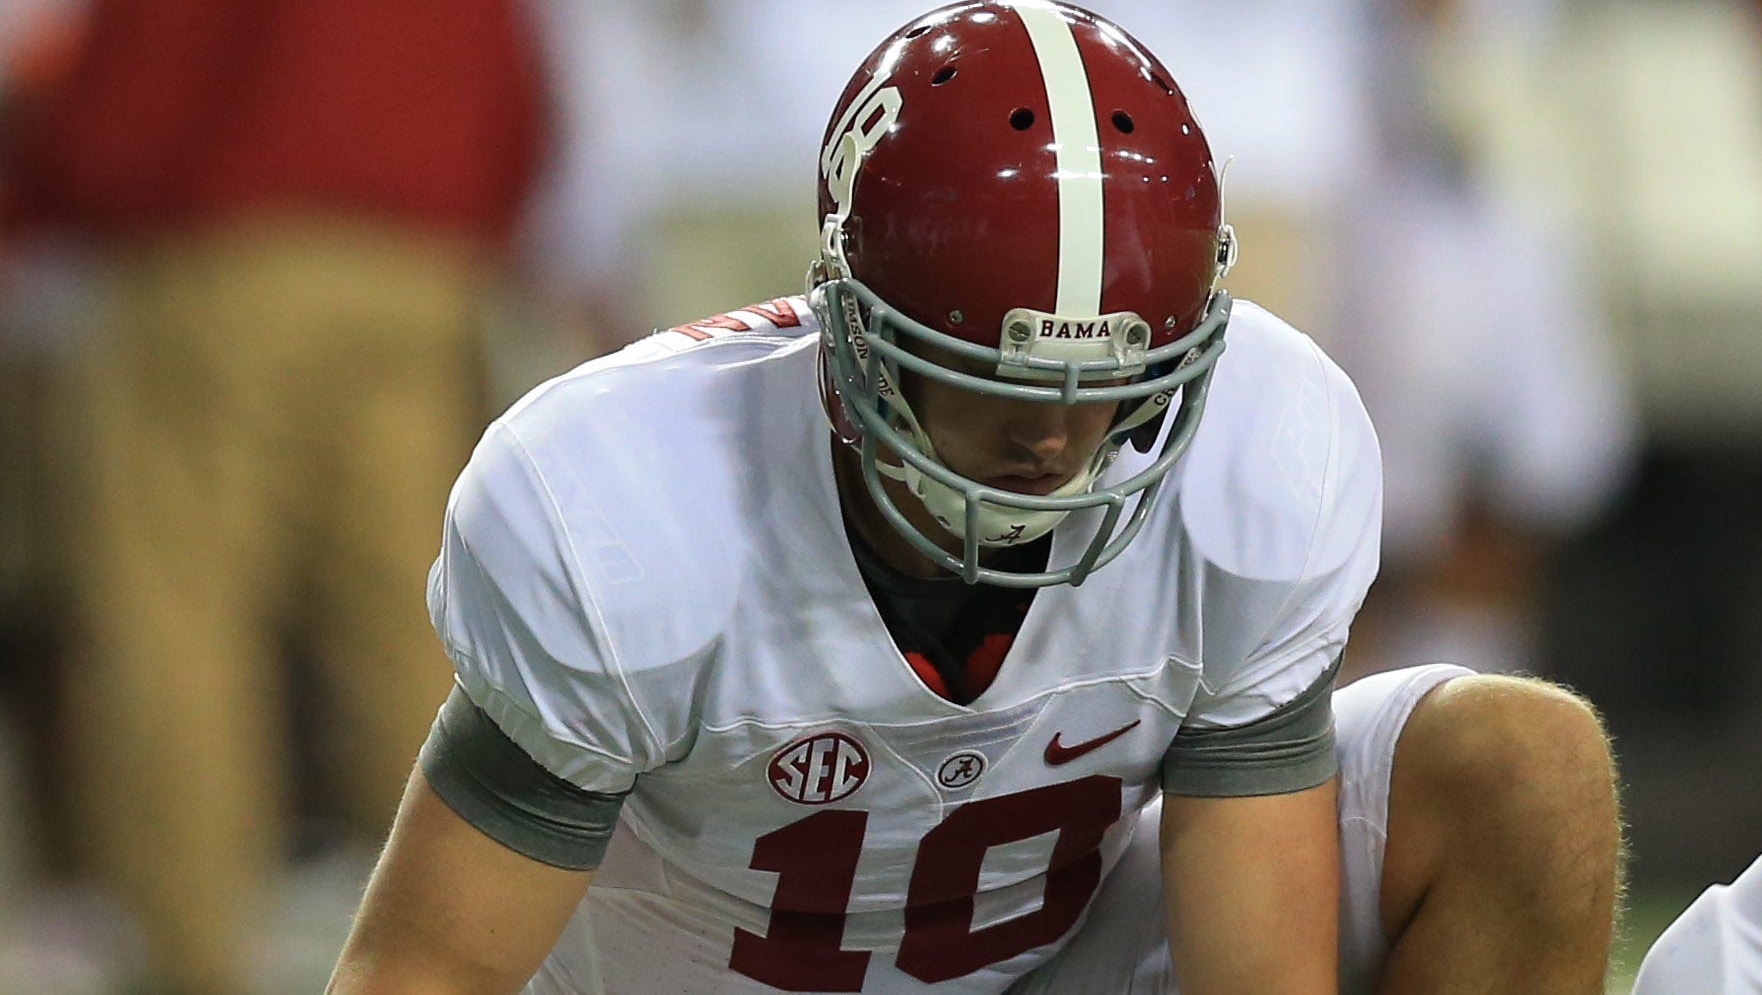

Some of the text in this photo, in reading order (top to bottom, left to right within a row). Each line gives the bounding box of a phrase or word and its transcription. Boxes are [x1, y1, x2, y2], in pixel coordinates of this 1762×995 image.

[1039, 320, 1111, 339] BAMA
[776, 738, 863, 800] SEC
[728, 774, 1123, 994] 10
